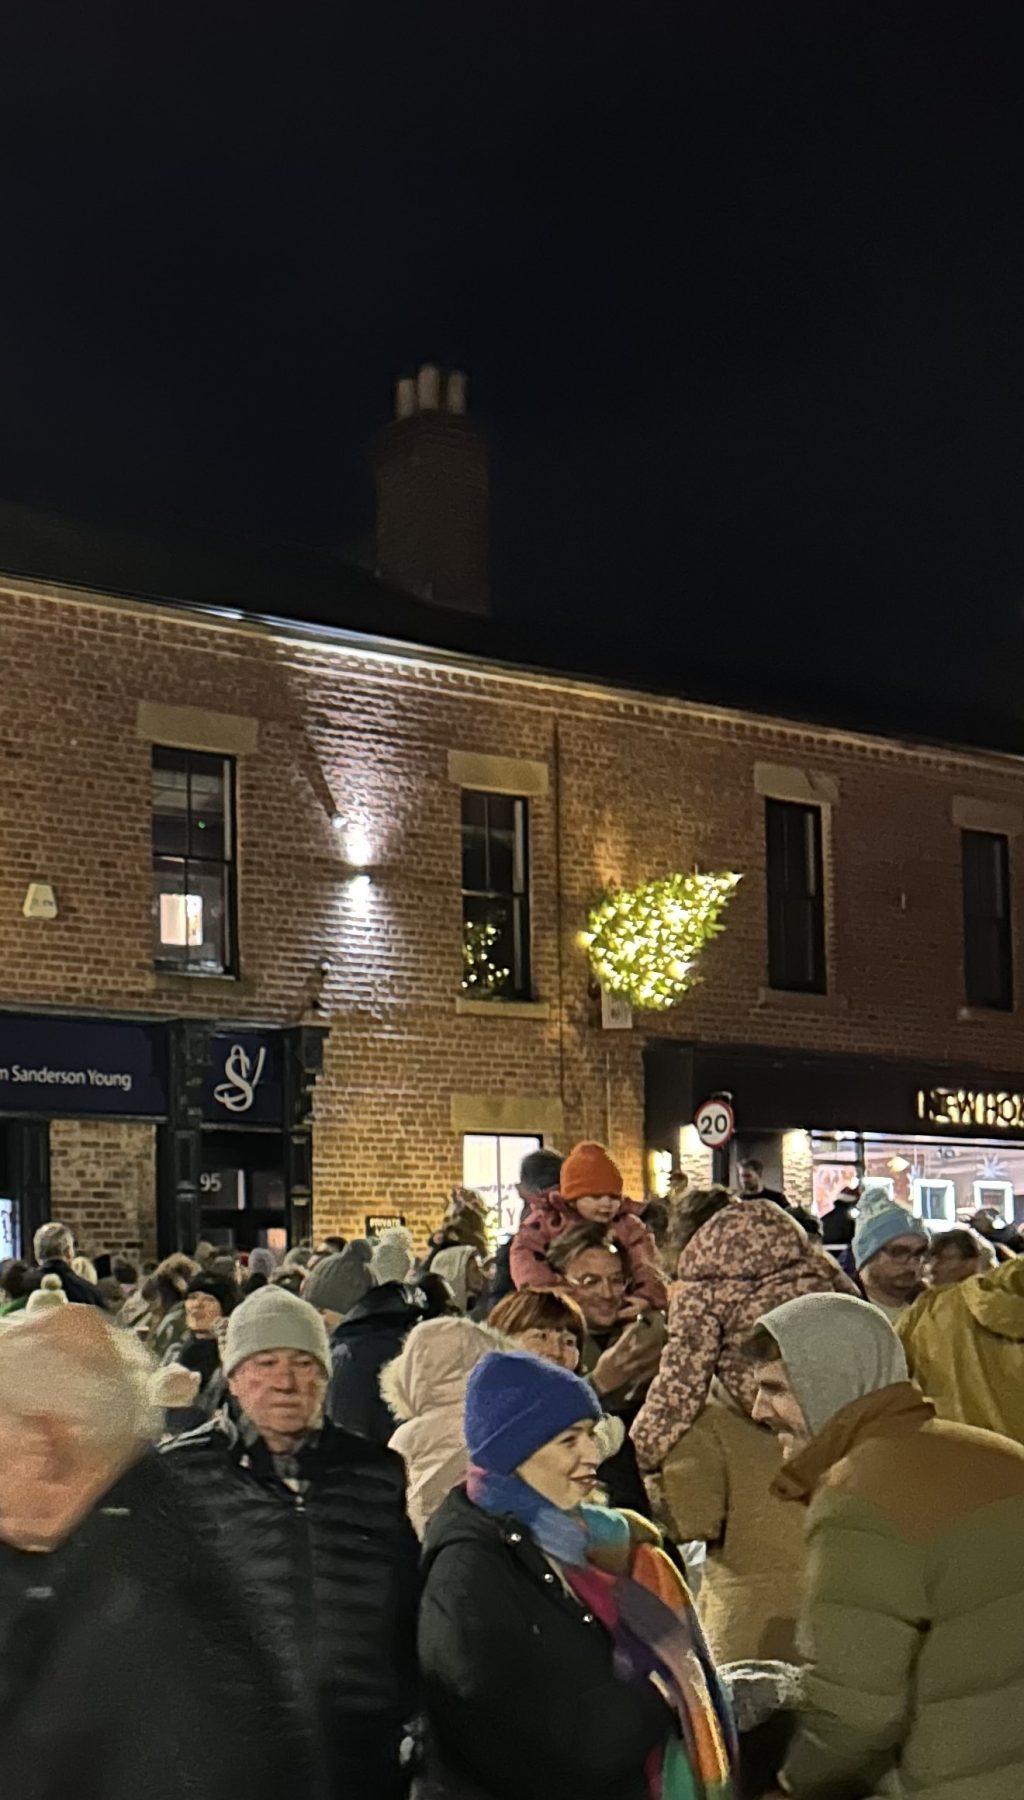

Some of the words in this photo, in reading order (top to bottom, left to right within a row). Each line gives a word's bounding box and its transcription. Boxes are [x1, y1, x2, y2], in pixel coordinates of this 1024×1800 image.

[12, 1064, 86, 1085] Sanderson
[87, 1069, 133, 1091] Young
[701, 1114, 727, 1135] 20
[199, 1172, 223, 1192] 95
